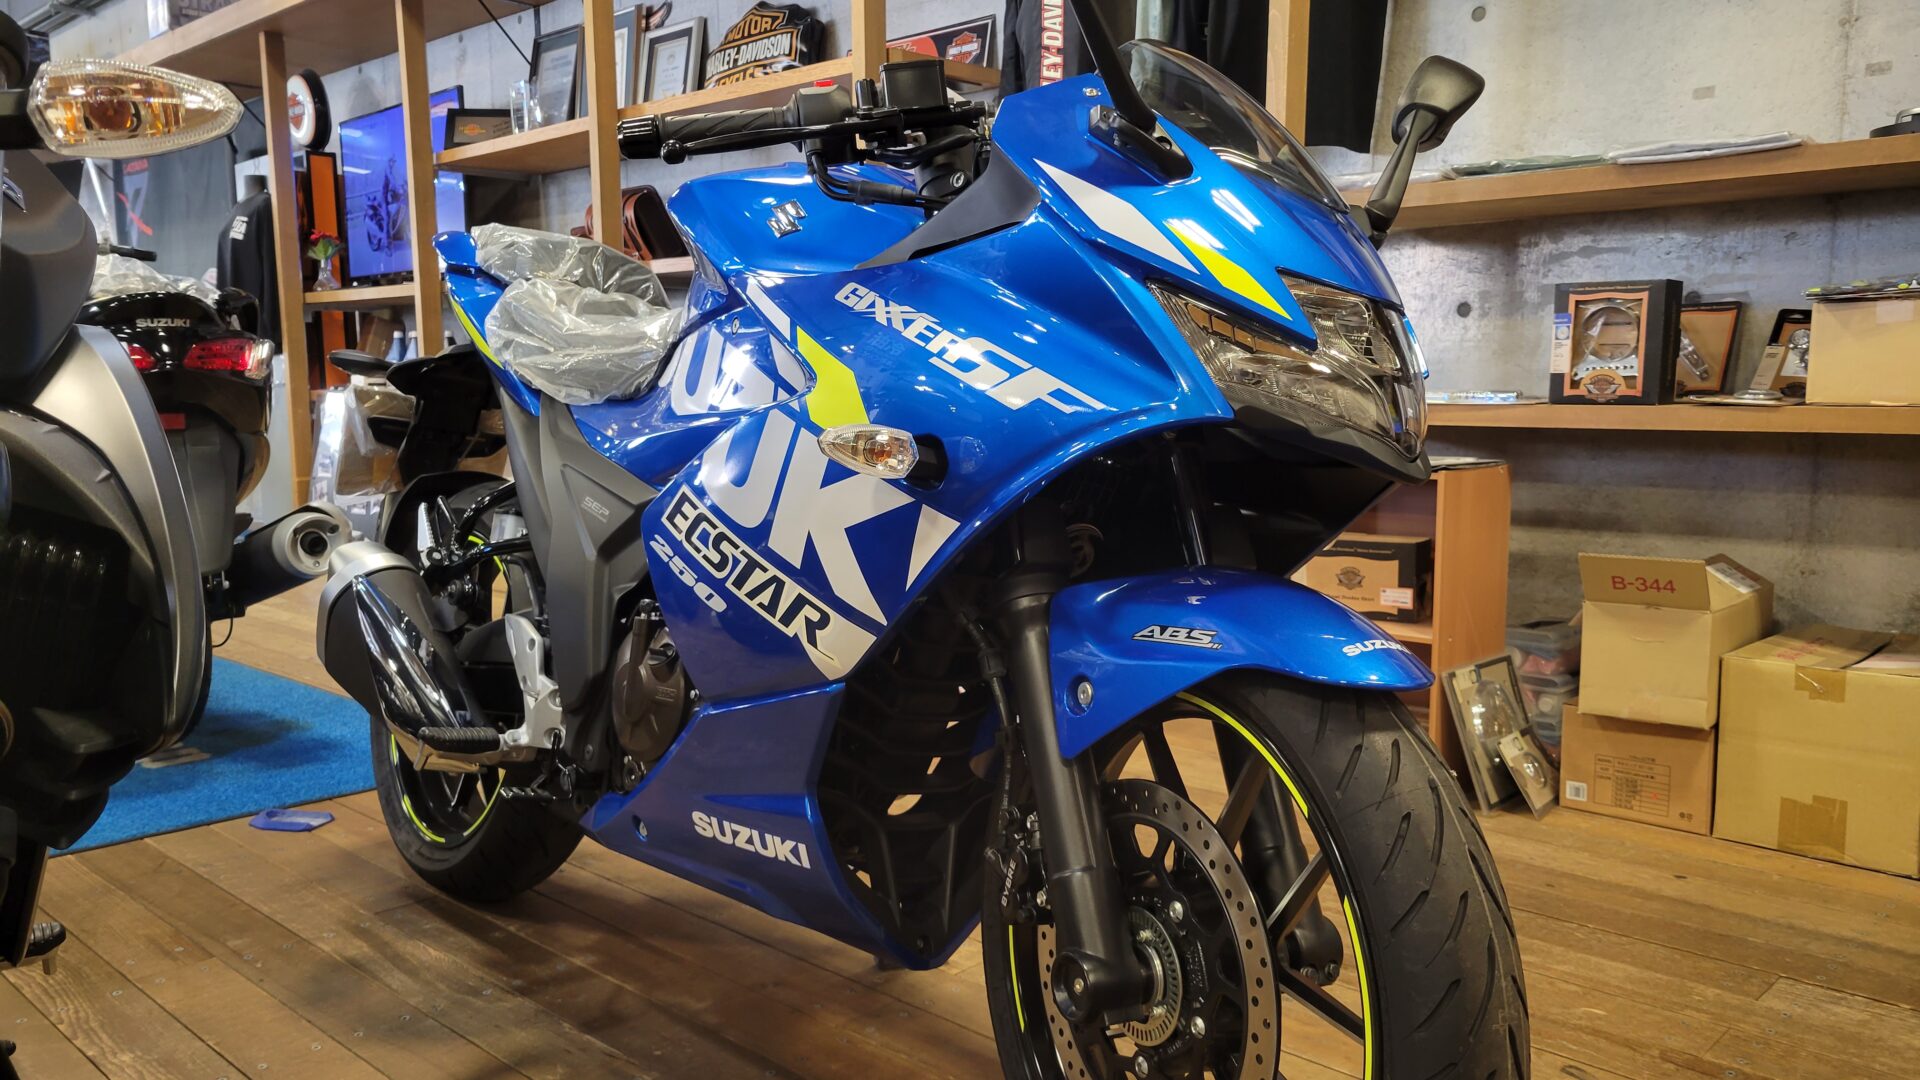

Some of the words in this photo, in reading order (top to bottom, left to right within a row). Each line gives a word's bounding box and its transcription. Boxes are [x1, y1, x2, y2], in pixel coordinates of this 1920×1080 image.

[727, 15, 774, 42] MOTOR
[135, 318, 190, 328] SUZUKI
[834, 281, 974, 363] GIXXER
[928, 336, 1107, 415] SF
[649, 534, 727, 613] 250
[663, 490, 836, 662] ECSTAR
[1611, 575, 1677, 594] B-344
[1133, 625, 1218, 644] ABS
[691, 810, 811, 869] SUZUKI
[1001, 858, 1017, 908] BYBRE
